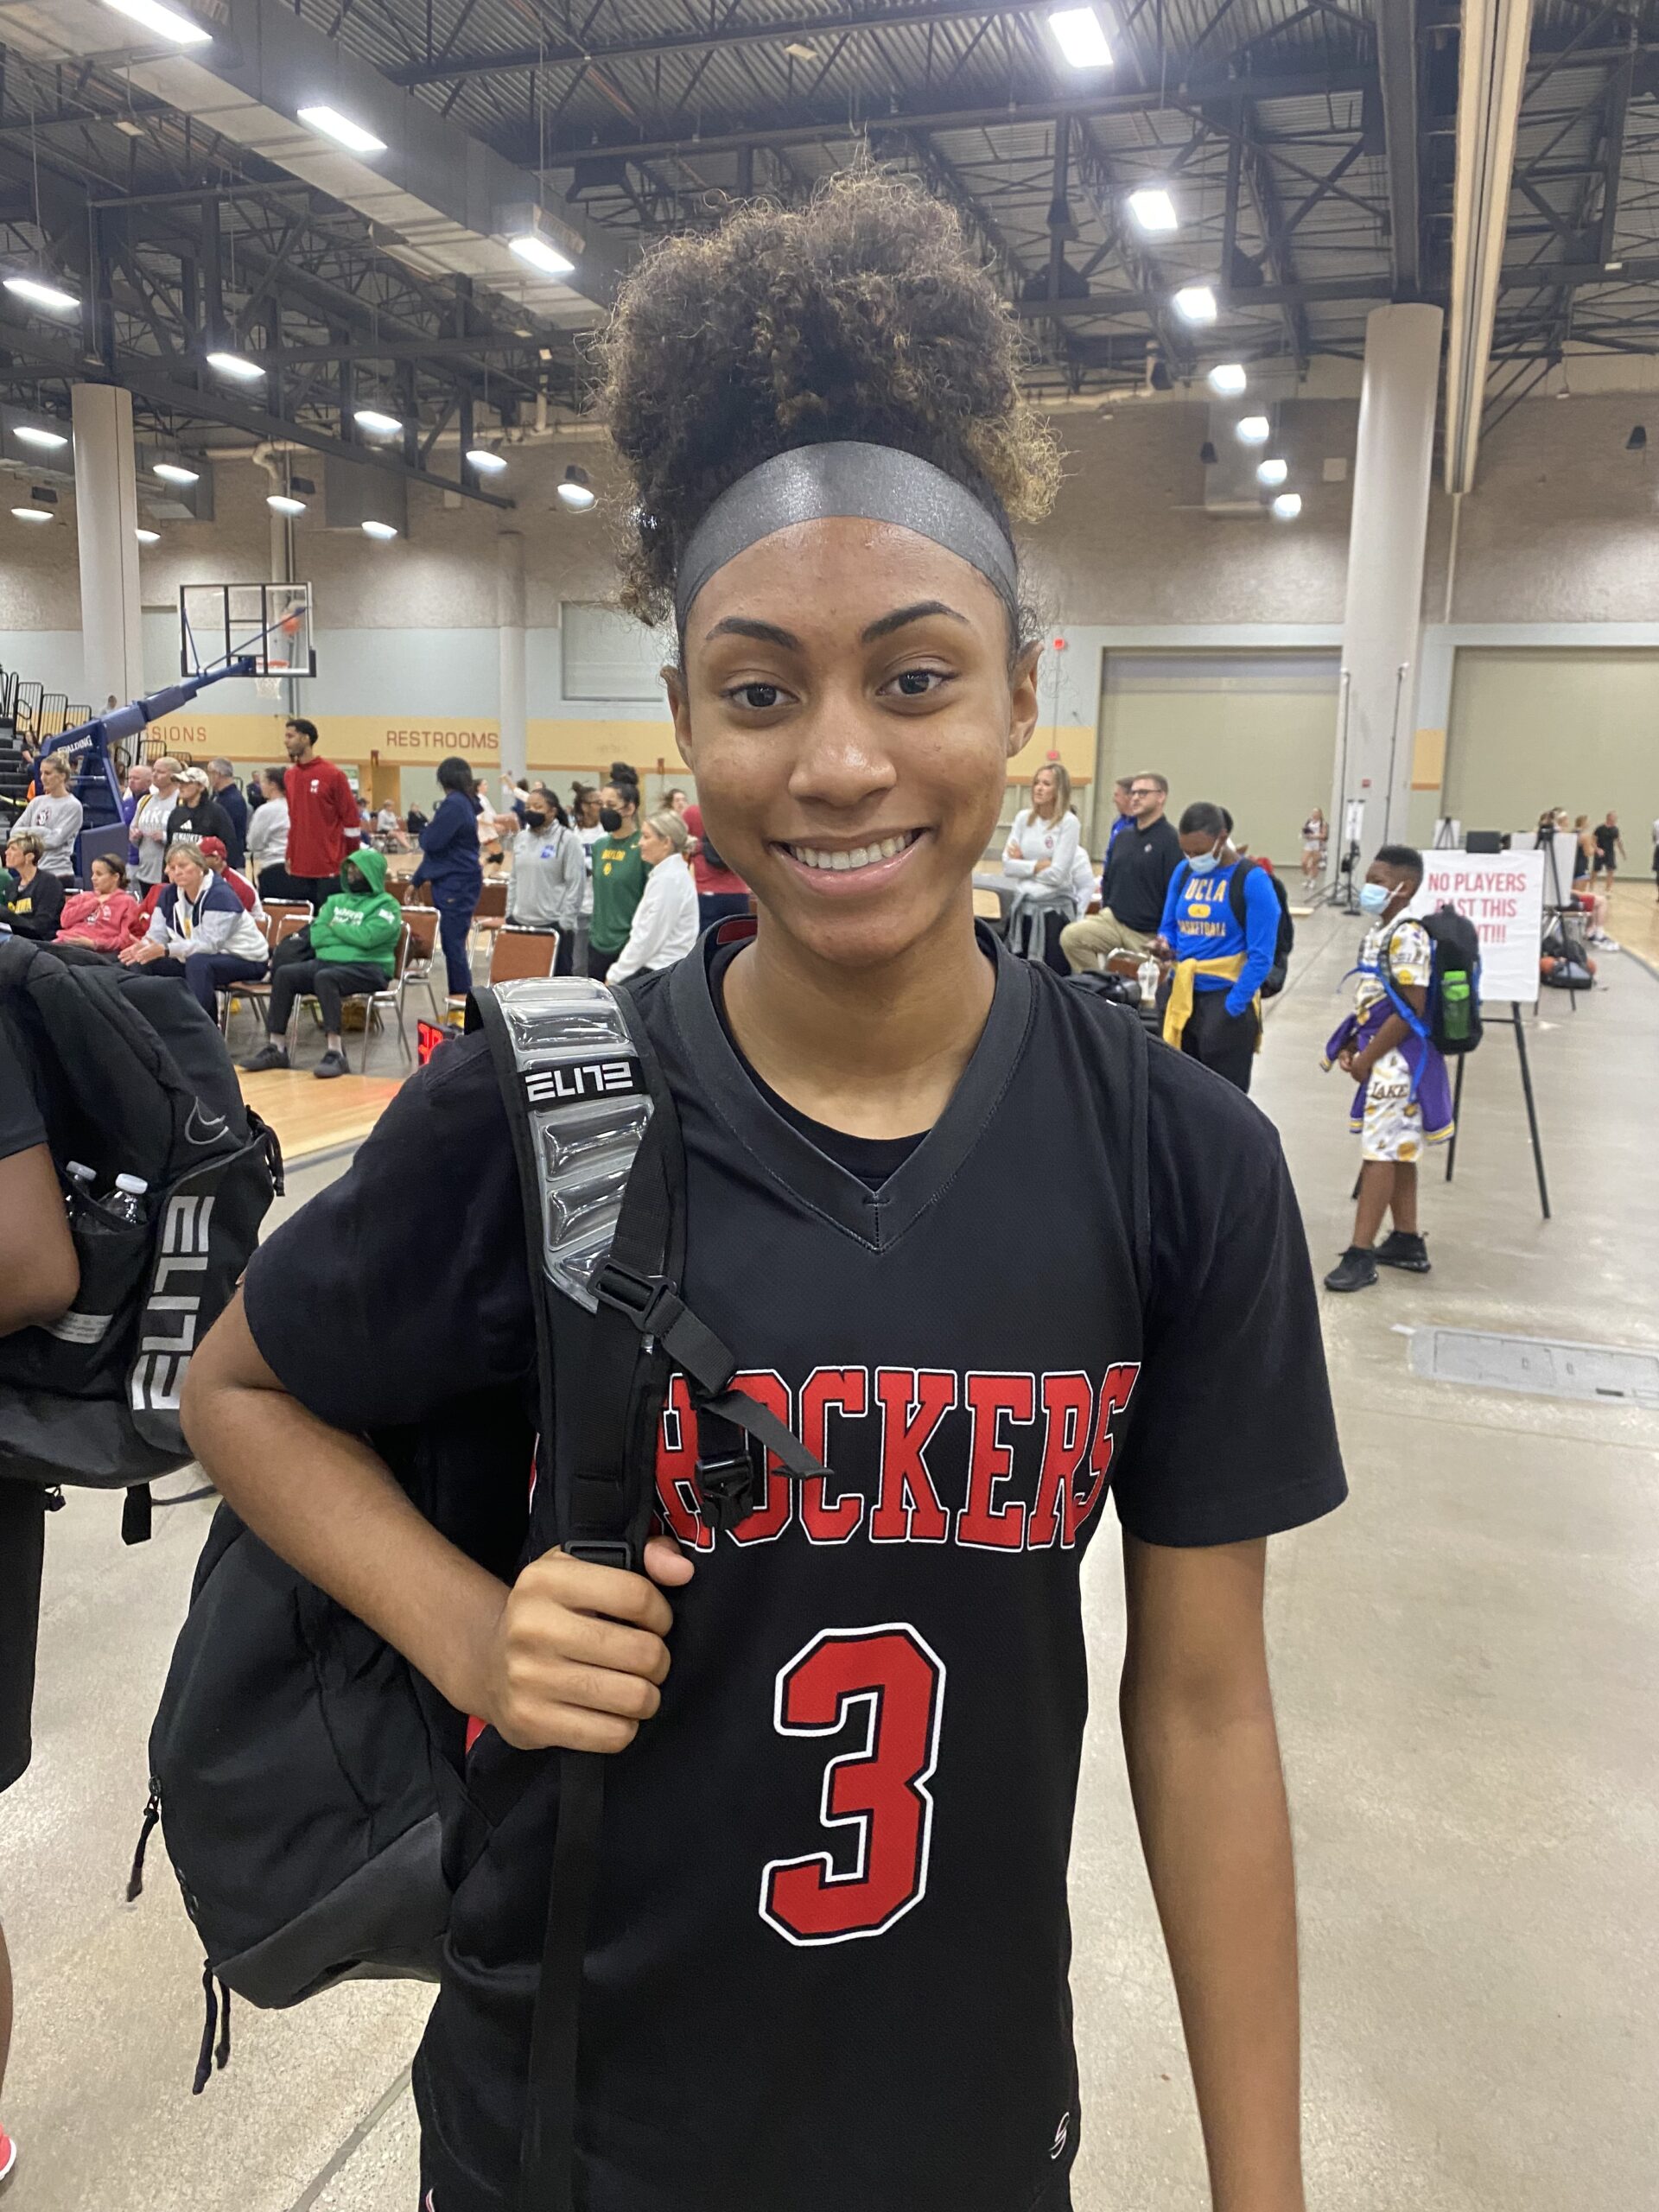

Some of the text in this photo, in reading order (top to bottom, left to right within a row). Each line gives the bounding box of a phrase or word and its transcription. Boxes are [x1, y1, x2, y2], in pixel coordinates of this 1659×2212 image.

[146, 726, 207, 742] SIONS
[386, 730, 499, 749] RESTROOMS
[1185, 878, 1227, 902] UCLA
[1428, 873, 1527, 892] NO PLAYERS
[1481, 898, 1516, 918] THIS
[525, 1061, 633, 1102] ELITE
[131, 1195, 215, 1410] ELITE
[650, 1362, 1141, 1554] HOCKERS
[759, 1623, 946, 1947] 3
